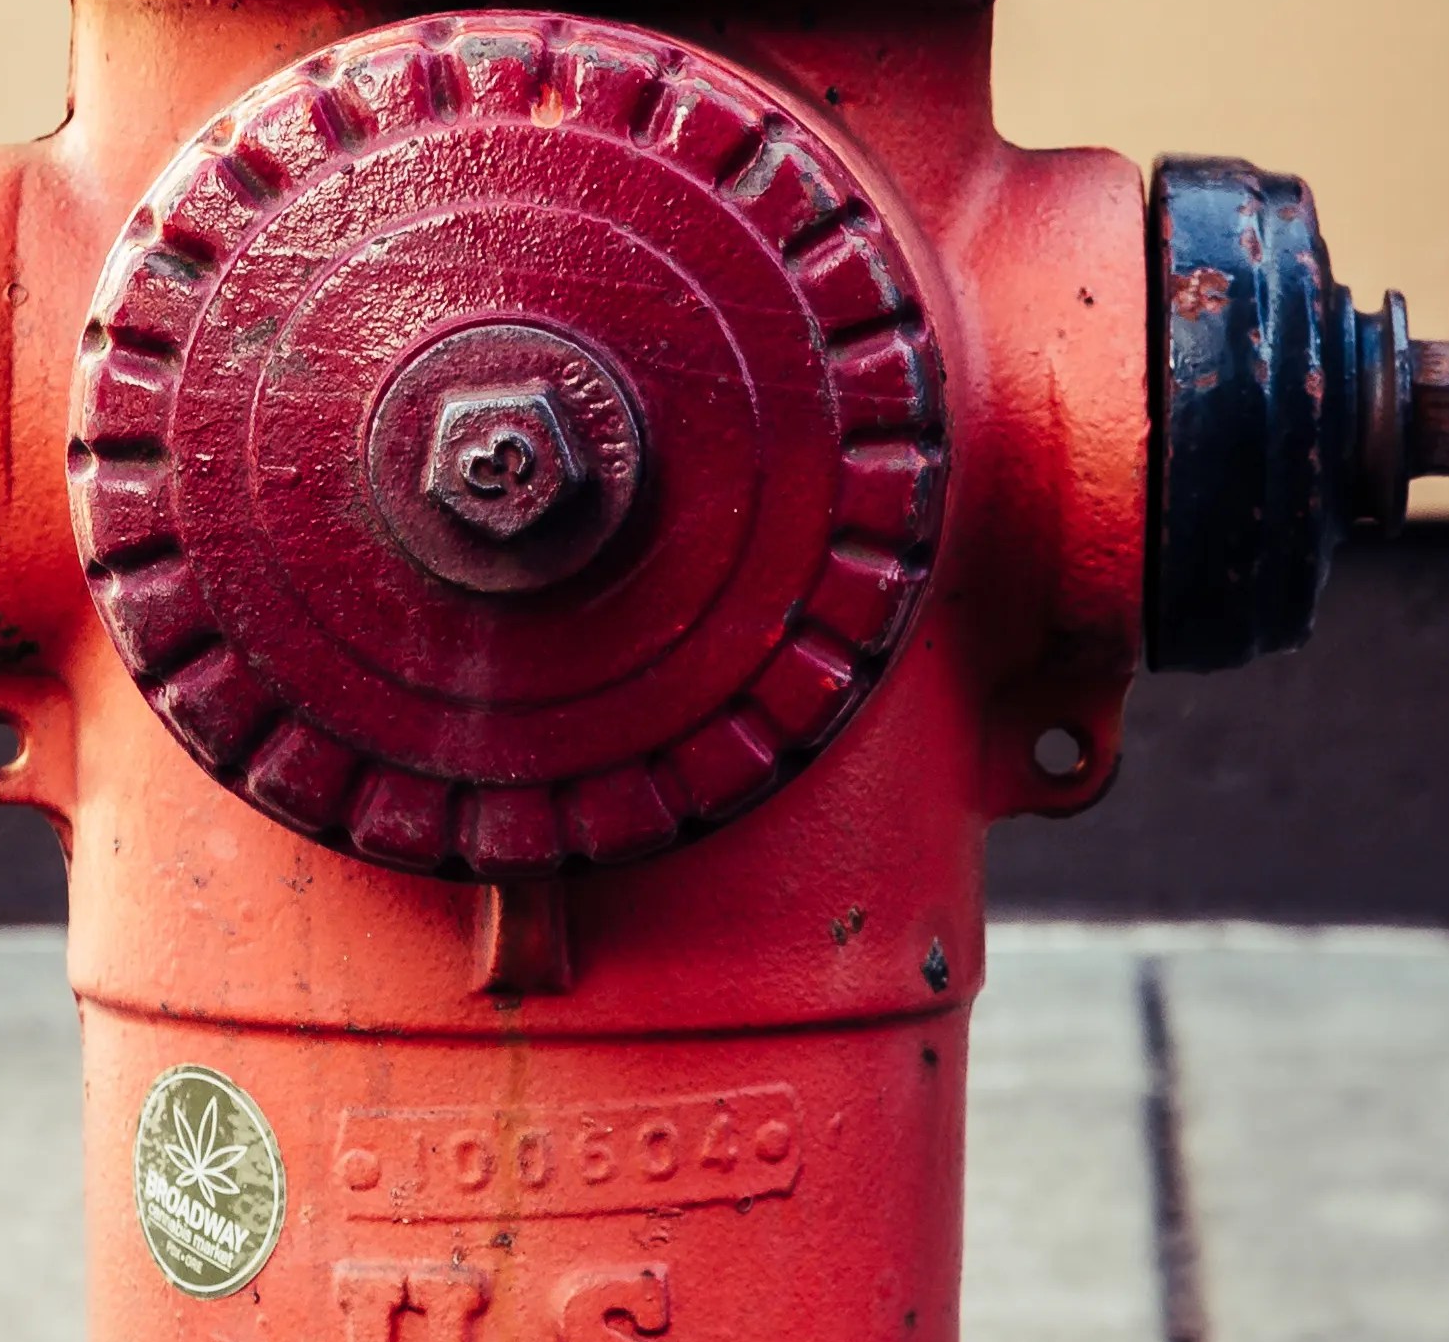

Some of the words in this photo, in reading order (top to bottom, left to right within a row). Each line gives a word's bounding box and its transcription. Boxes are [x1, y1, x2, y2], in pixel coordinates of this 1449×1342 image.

[145, 1168, 249, 1253] BROADWAY
[148, 1202, 193, 1245] cannabis
[192, 1232, 235, 1268] market
